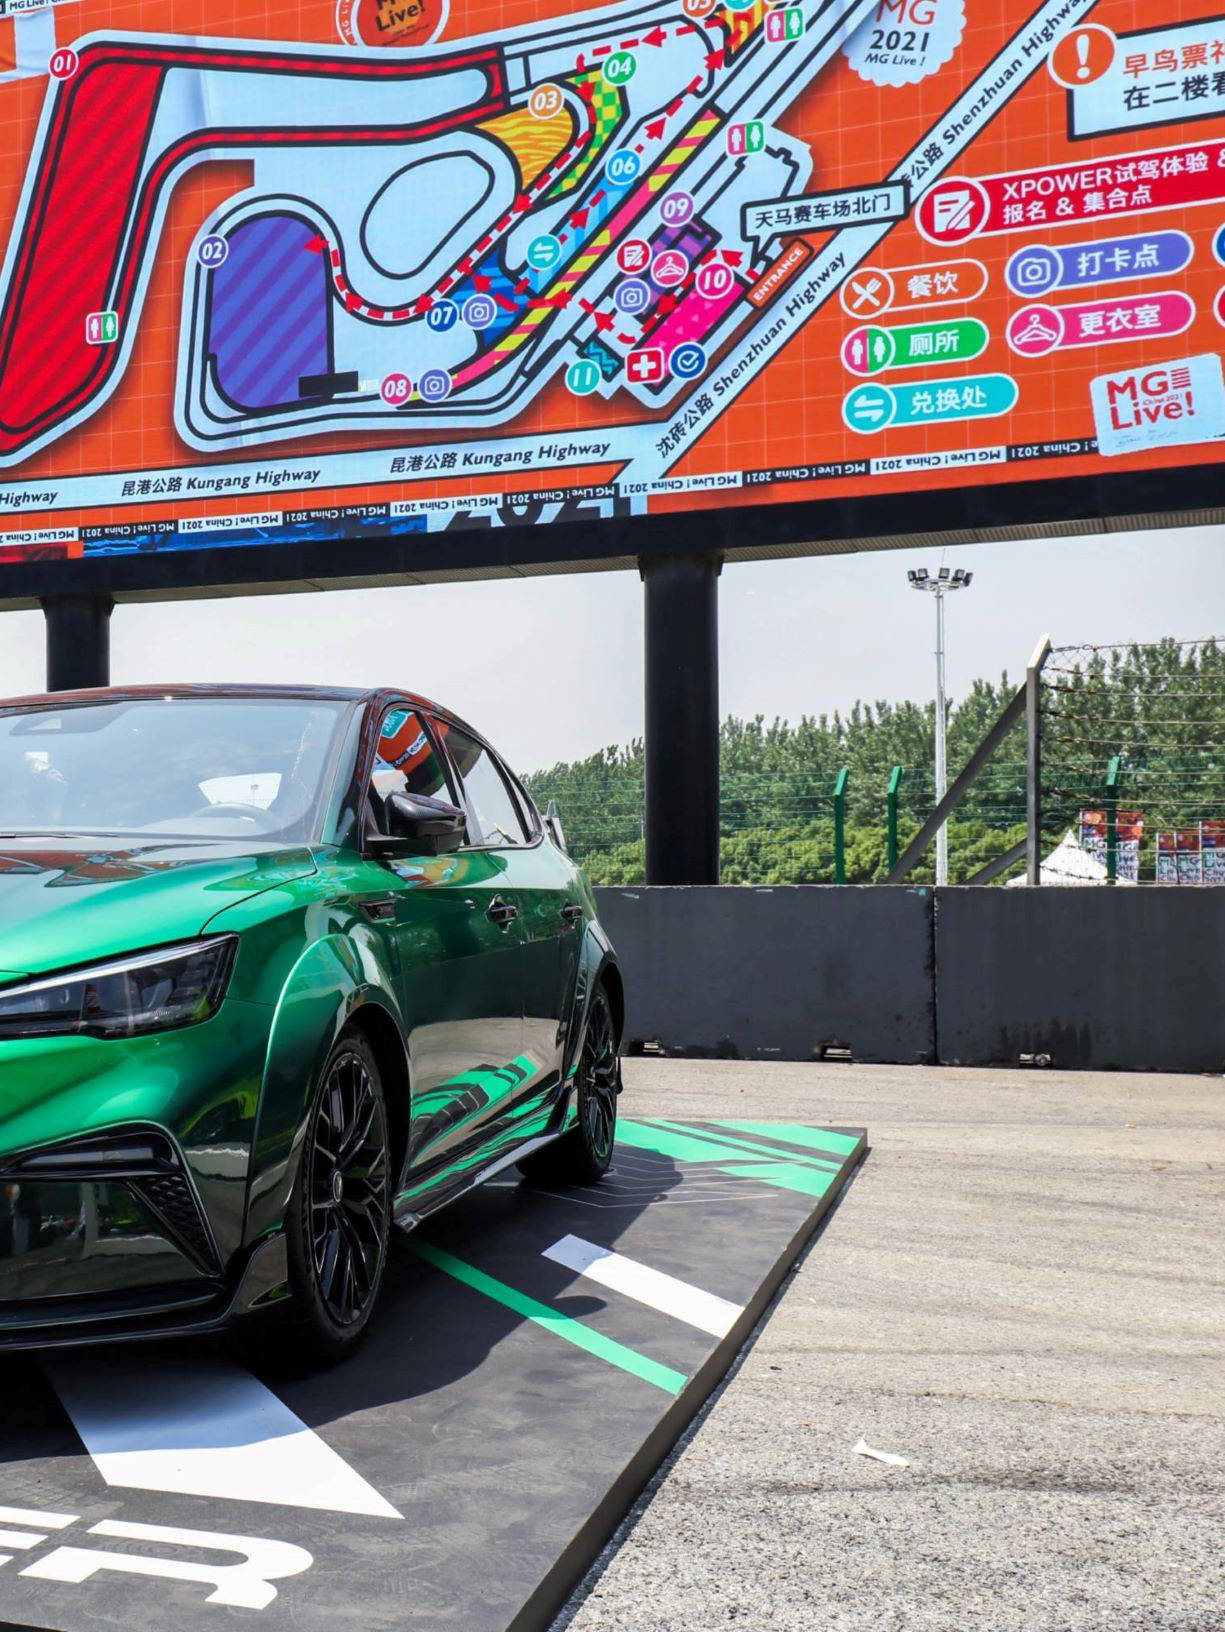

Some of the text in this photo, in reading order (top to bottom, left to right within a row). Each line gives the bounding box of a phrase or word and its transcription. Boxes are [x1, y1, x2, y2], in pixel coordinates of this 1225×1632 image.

[376, 0, 425, 31] Live!
[876, 0, 935, 25] MG
[870, 30, 930, 52] 2021
[54, 56, 72, 72] 01
[608, 59, 632, 75] 04
[865, 53, 889, 64] MG
[942, 0, 1086, 145] Shenzhuan Highwa
[534, 92, 558, 110] 03
[612, 157, 635, 174] 06
[664, 201, 688, 218] 09
[755, 193, 891, 227] 天马赛车场北门
[1003, 185, 1152, 225] 报名 & 集合点
[202, 243, 223, 262] 02
[1078, 243, 1159, 277] 打卡点
[703, 269, 727, 290] 10
[754, 248, 805, 302] ENTRANCE
[907, 271, 959, 299] 餐饮
[431, 307, 455, 326] 07
[1079, 304, 1161, 338] 更衣室
[656, 252, 847, 459] 沈砖公路 Shenzhuan Highway
[909, 329, 960, 357] 厕所
[383, 380, 407, 398] 08
[573, 367, 593, 387] 11
[1107, 371, 1169, 405] MG
[910, 385, 988, 415] 兑换处
[1110, 391, 1195, 431] Live!
[390, 441, 611, 474] 昆港公路 Kungang Highway
[121, 468, 321, 496] 昆港公路 Kungang Highway
